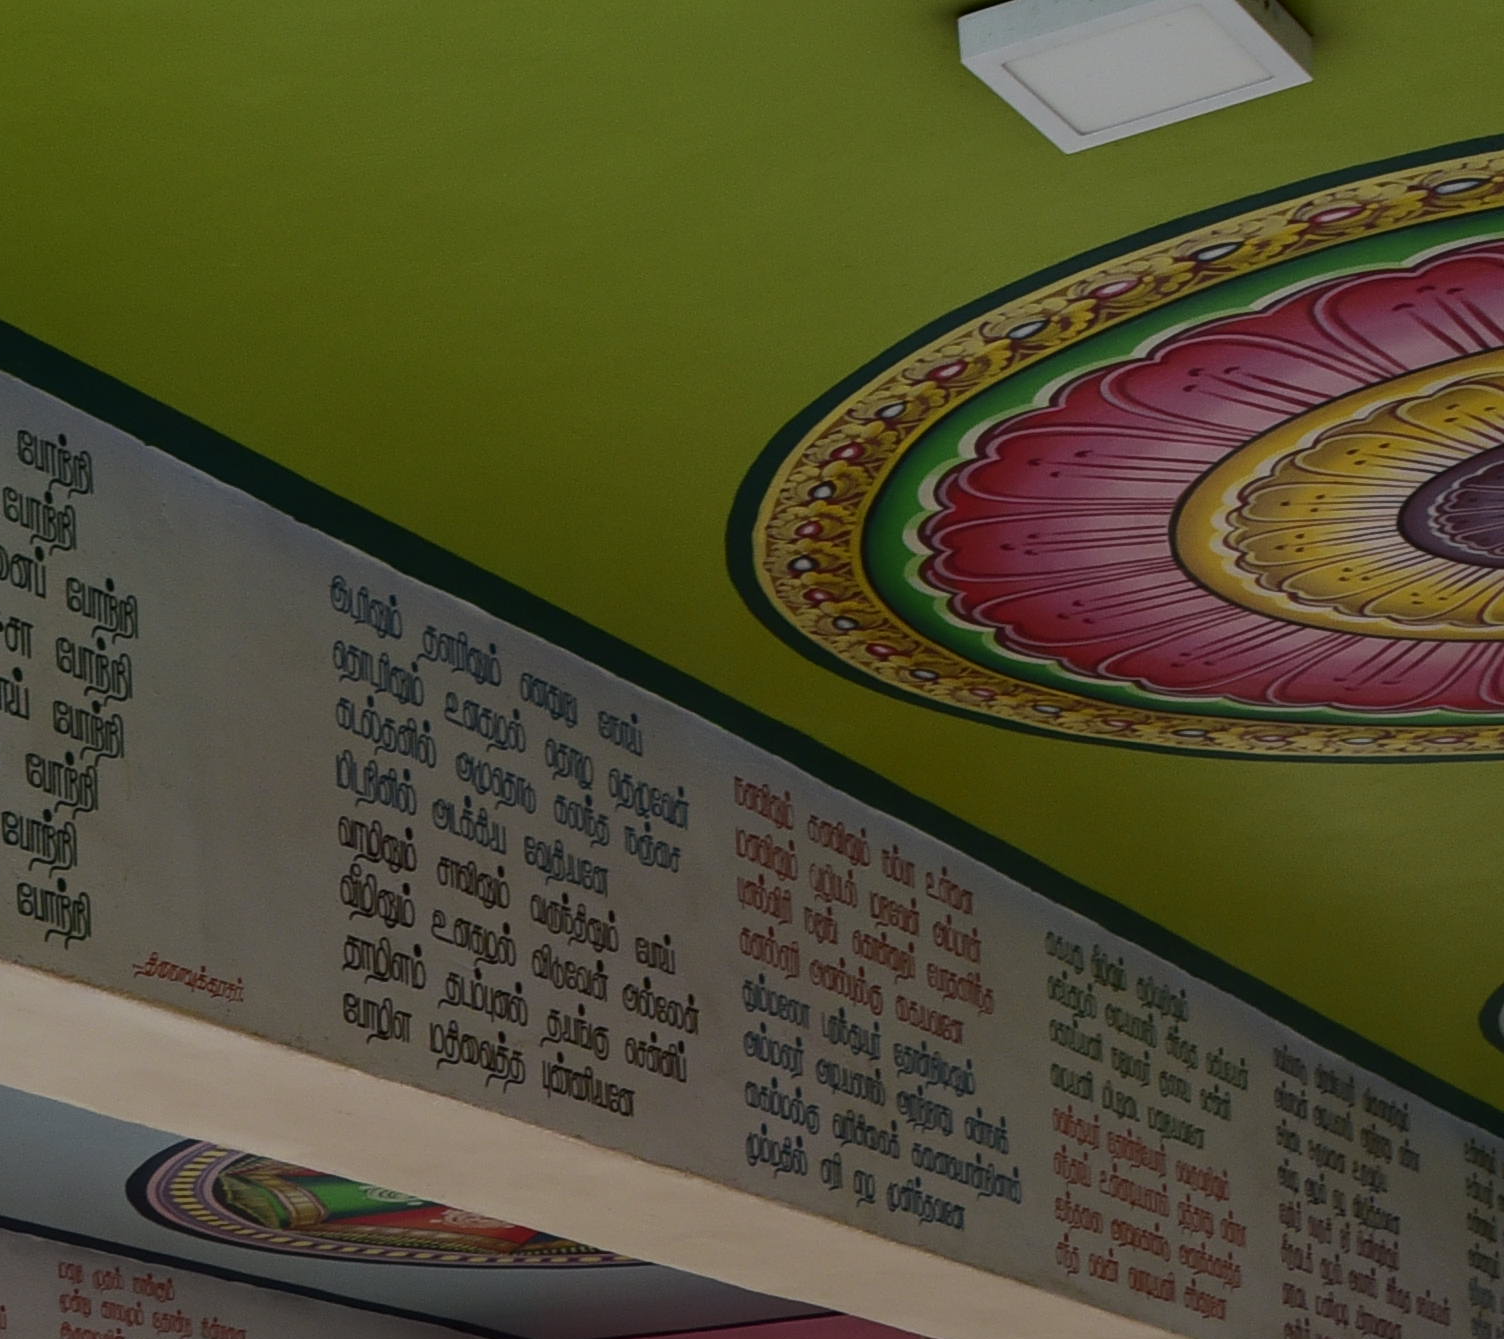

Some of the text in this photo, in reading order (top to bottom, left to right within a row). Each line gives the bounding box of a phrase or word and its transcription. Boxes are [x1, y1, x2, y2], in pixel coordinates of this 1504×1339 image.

[17, 429, 93, 504] போற்றி
[55, 636, 133, 715] போற்றி
[53, 700, 123, 767] போற்றி
[0, 808, 78, 880] போற்றி
